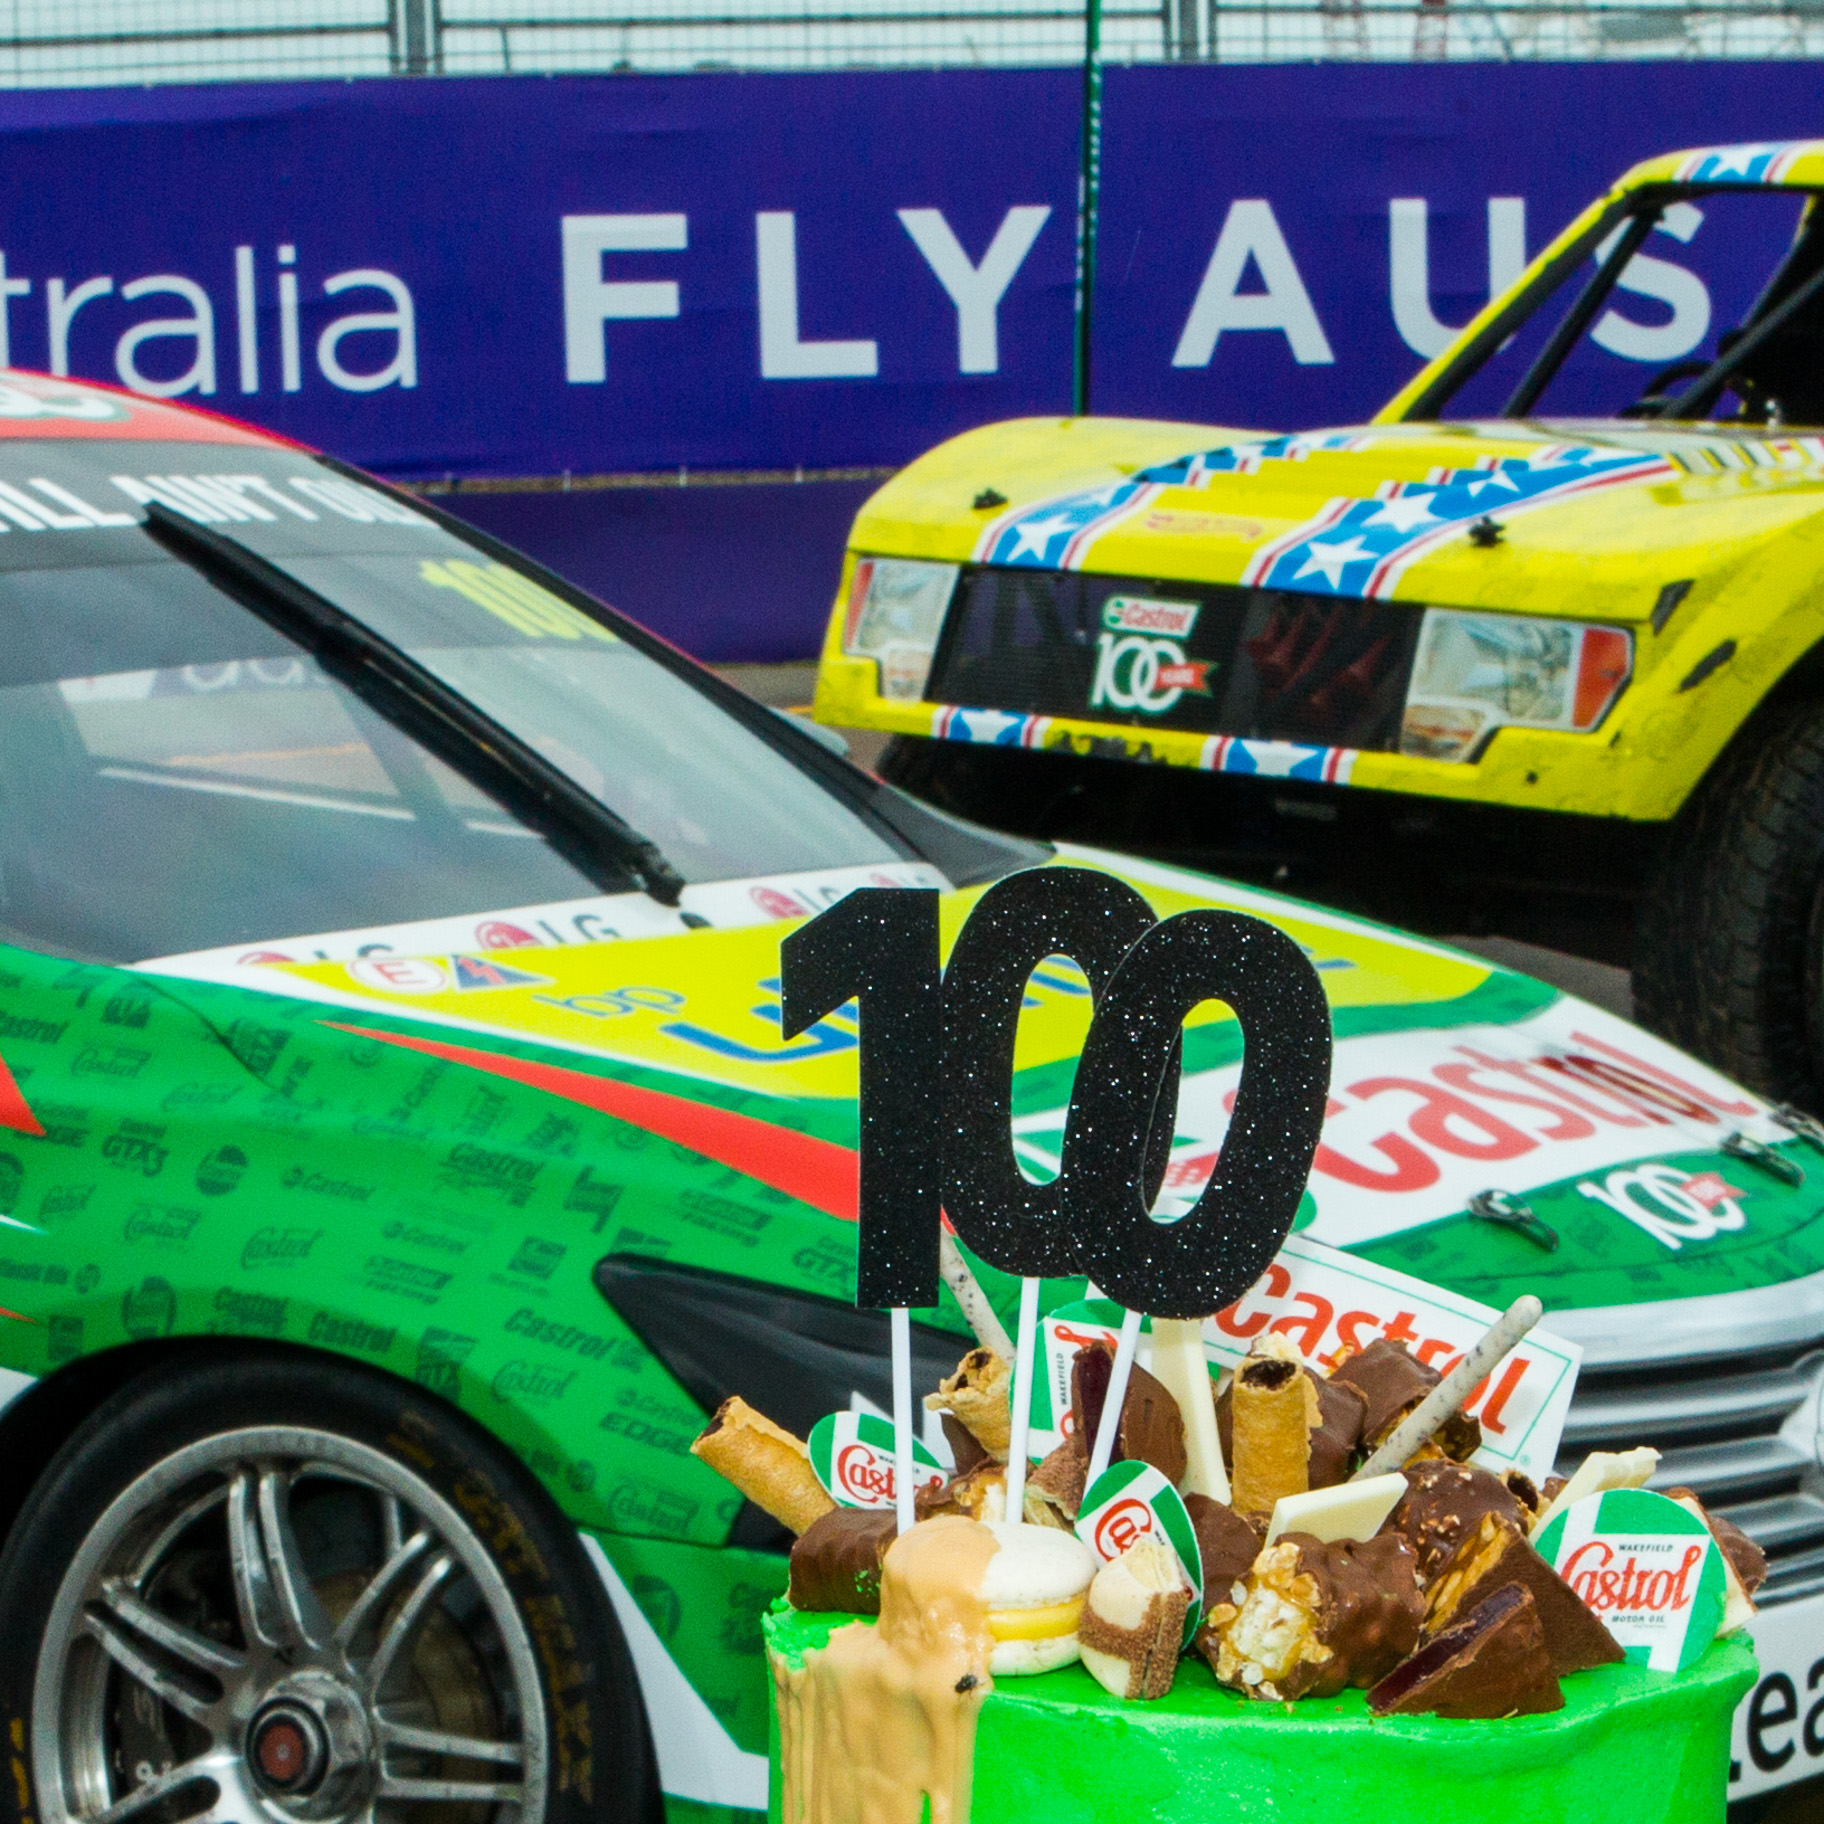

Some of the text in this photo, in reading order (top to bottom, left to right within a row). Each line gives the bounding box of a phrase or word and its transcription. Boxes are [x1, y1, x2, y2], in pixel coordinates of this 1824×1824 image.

[561, 205, 1052, 384] FLY
[780, 866, 1332, 1320] 100
[1580, 1165, 1749, 1253] 100
[837, 1444, 944, 1504] Cast
[1560, 1541, 1702, 1612] Castrol
